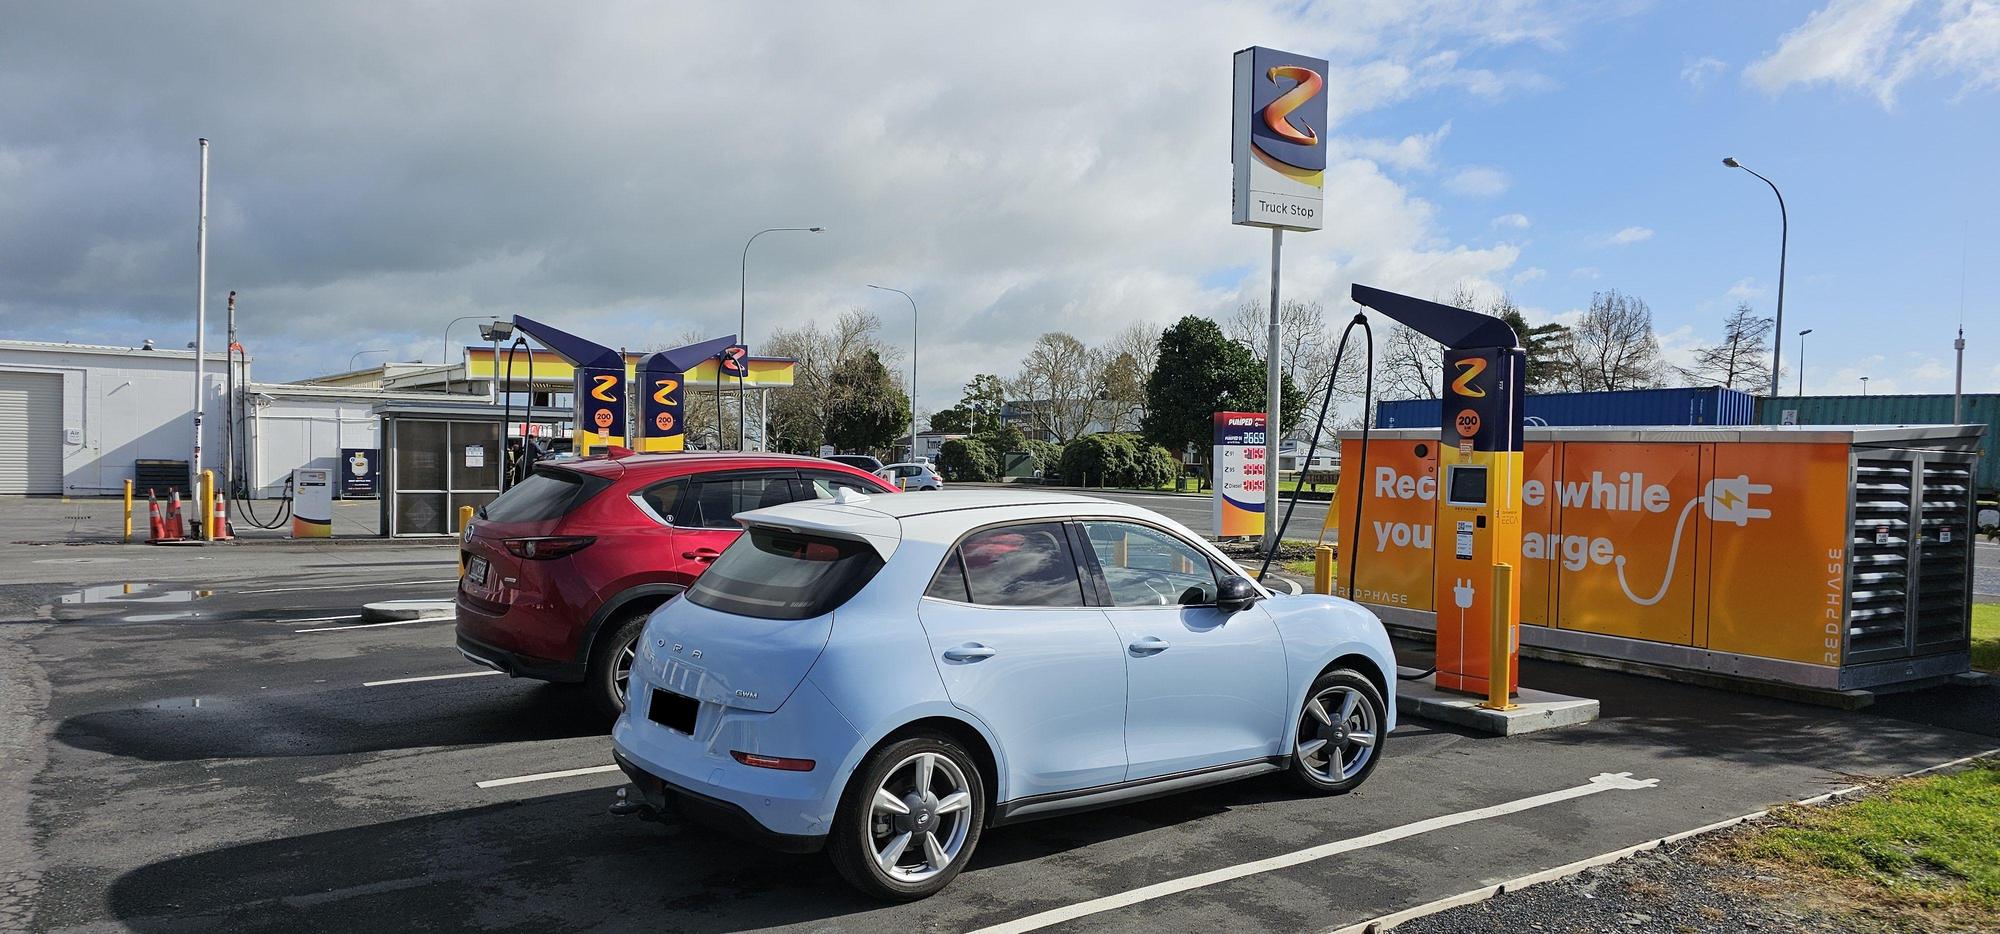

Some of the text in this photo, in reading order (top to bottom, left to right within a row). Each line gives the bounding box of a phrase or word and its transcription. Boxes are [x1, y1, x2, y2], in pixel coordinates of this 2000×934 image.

[1259, 200, 1314, 218] Truck Stop
[1228, 417, 1253, 426] PUMPED
[1458, 416, 1478, 426] 200
[1243, 432, 1265, 444] 2669
[1554, 471, 1670, 513] while
[1373, 521, 1433, 552] you
[1338, 586, 1408, 604] REDPHASE
[1824, 548, 1842, 663] REDPHASE
[657, 638, 703, 659] ORA
[735, 689, 758, 699] GWM
